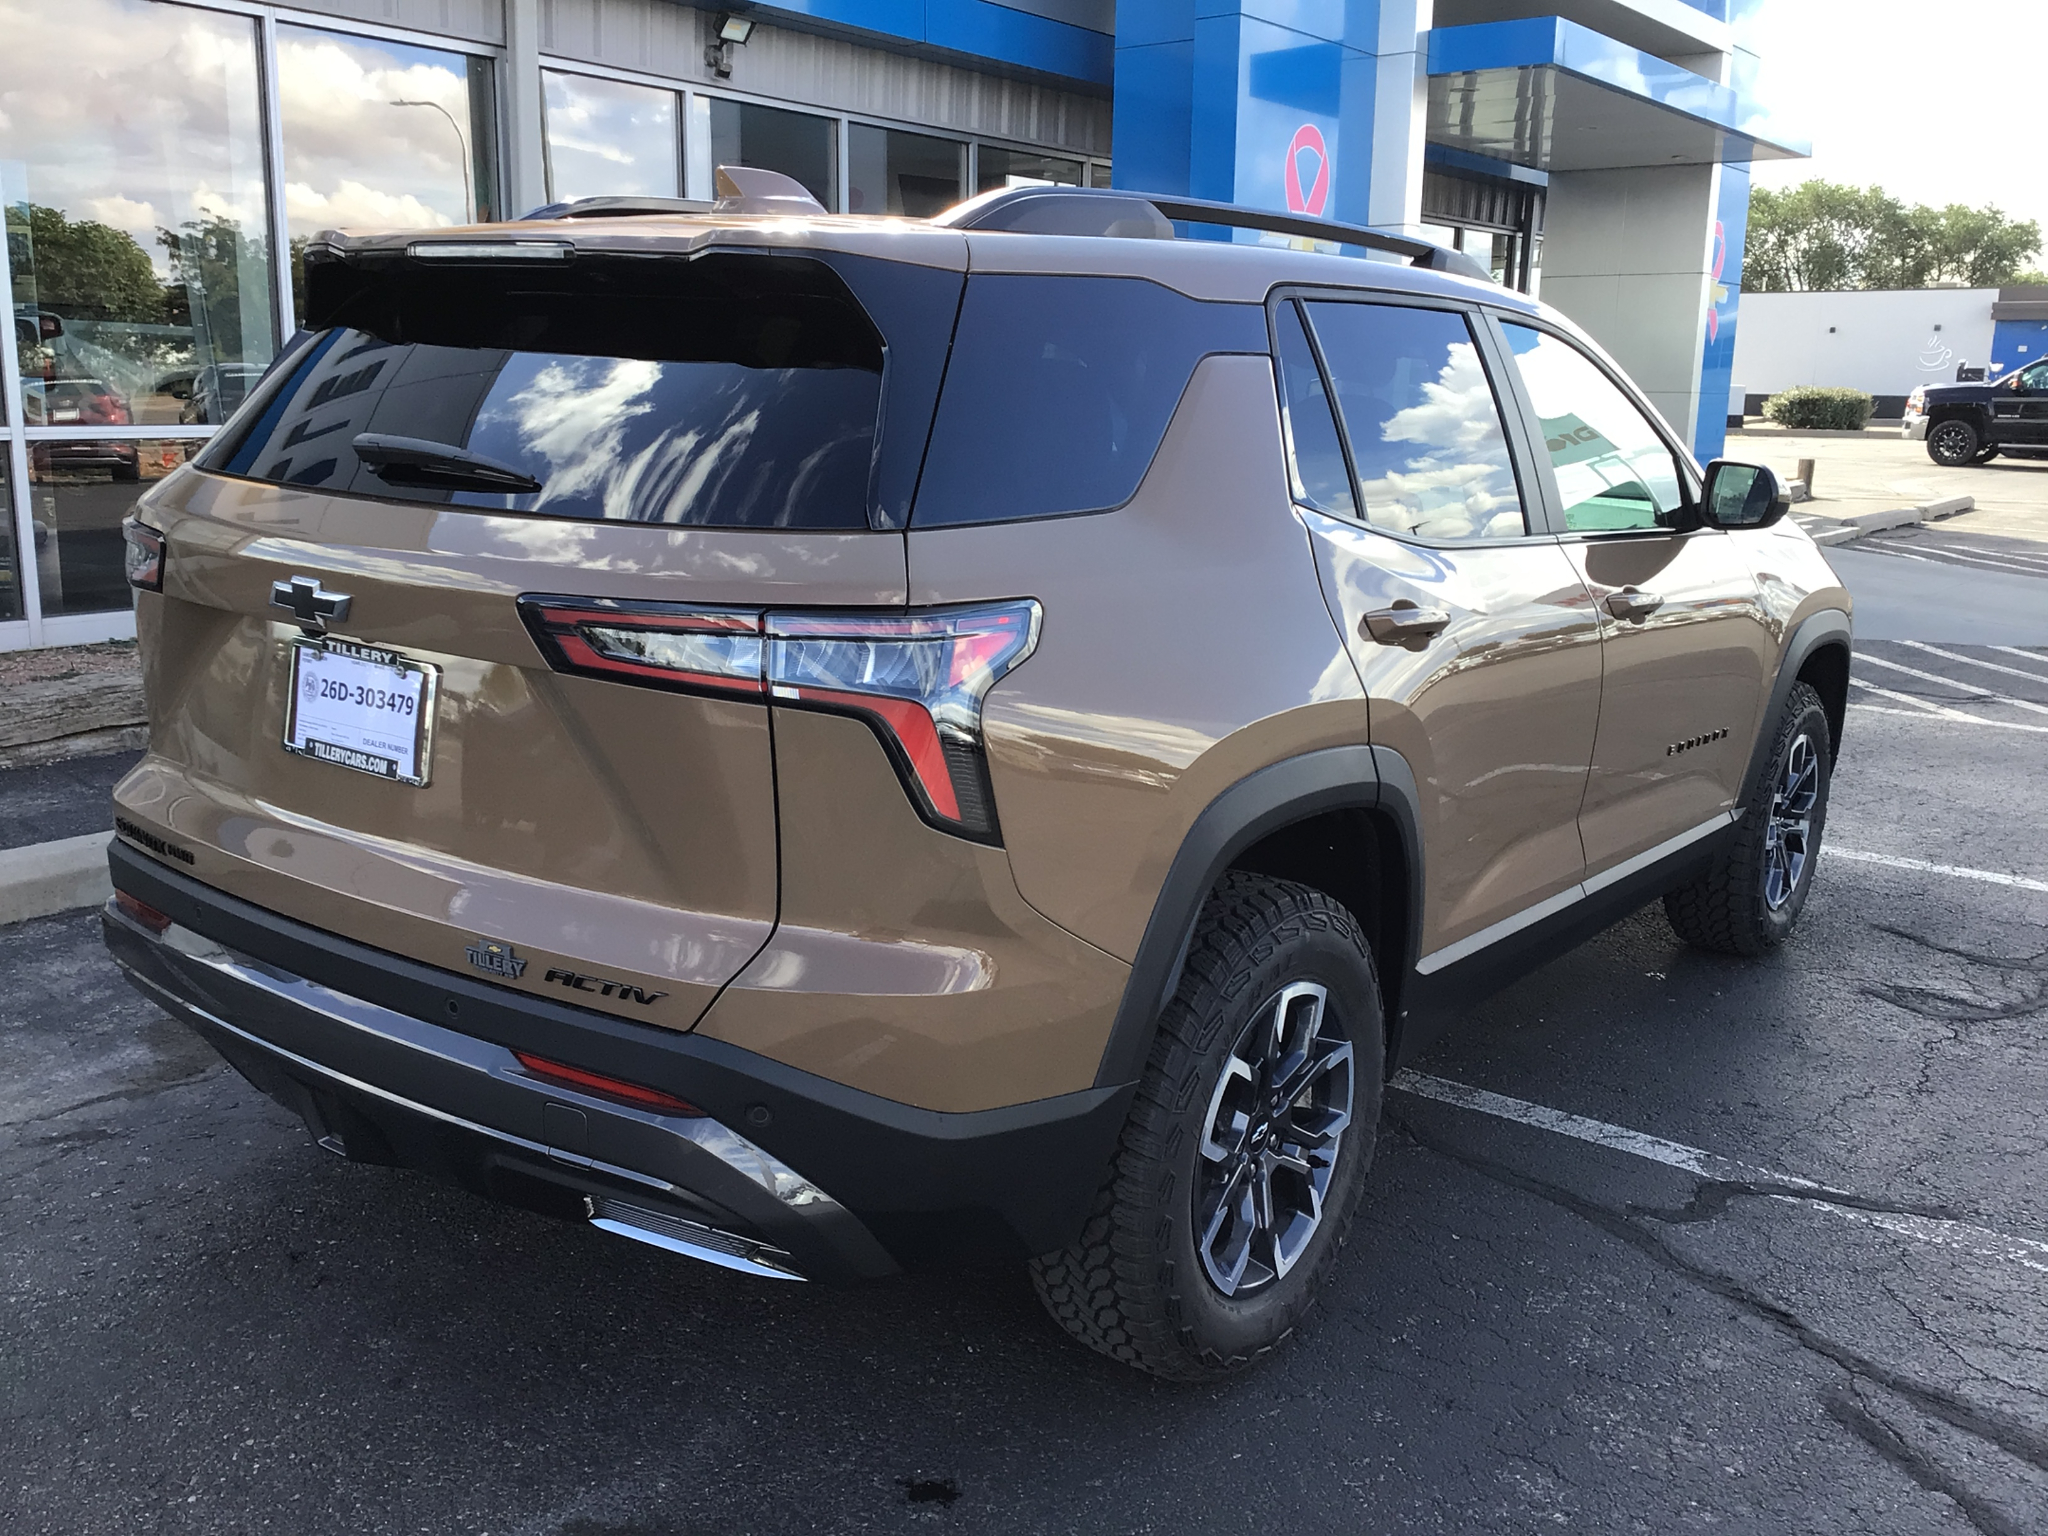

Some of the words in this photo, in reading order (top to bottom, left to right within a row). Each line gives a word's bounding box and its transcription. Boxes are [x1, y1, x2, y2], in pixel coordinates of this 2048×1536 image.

[326, 640, 393, 664] TILLERY
[320, 678, 414, 716] 26D-303479
[314, 742, 388, 775] TILLERYCARS.COM
[362, 737, 387, 751] DEALER
[387, 742, 409, 755] NUMBER
[465, 949, 524, 977] TILLERY
[544, 967, 670, 1006] ACTIV
